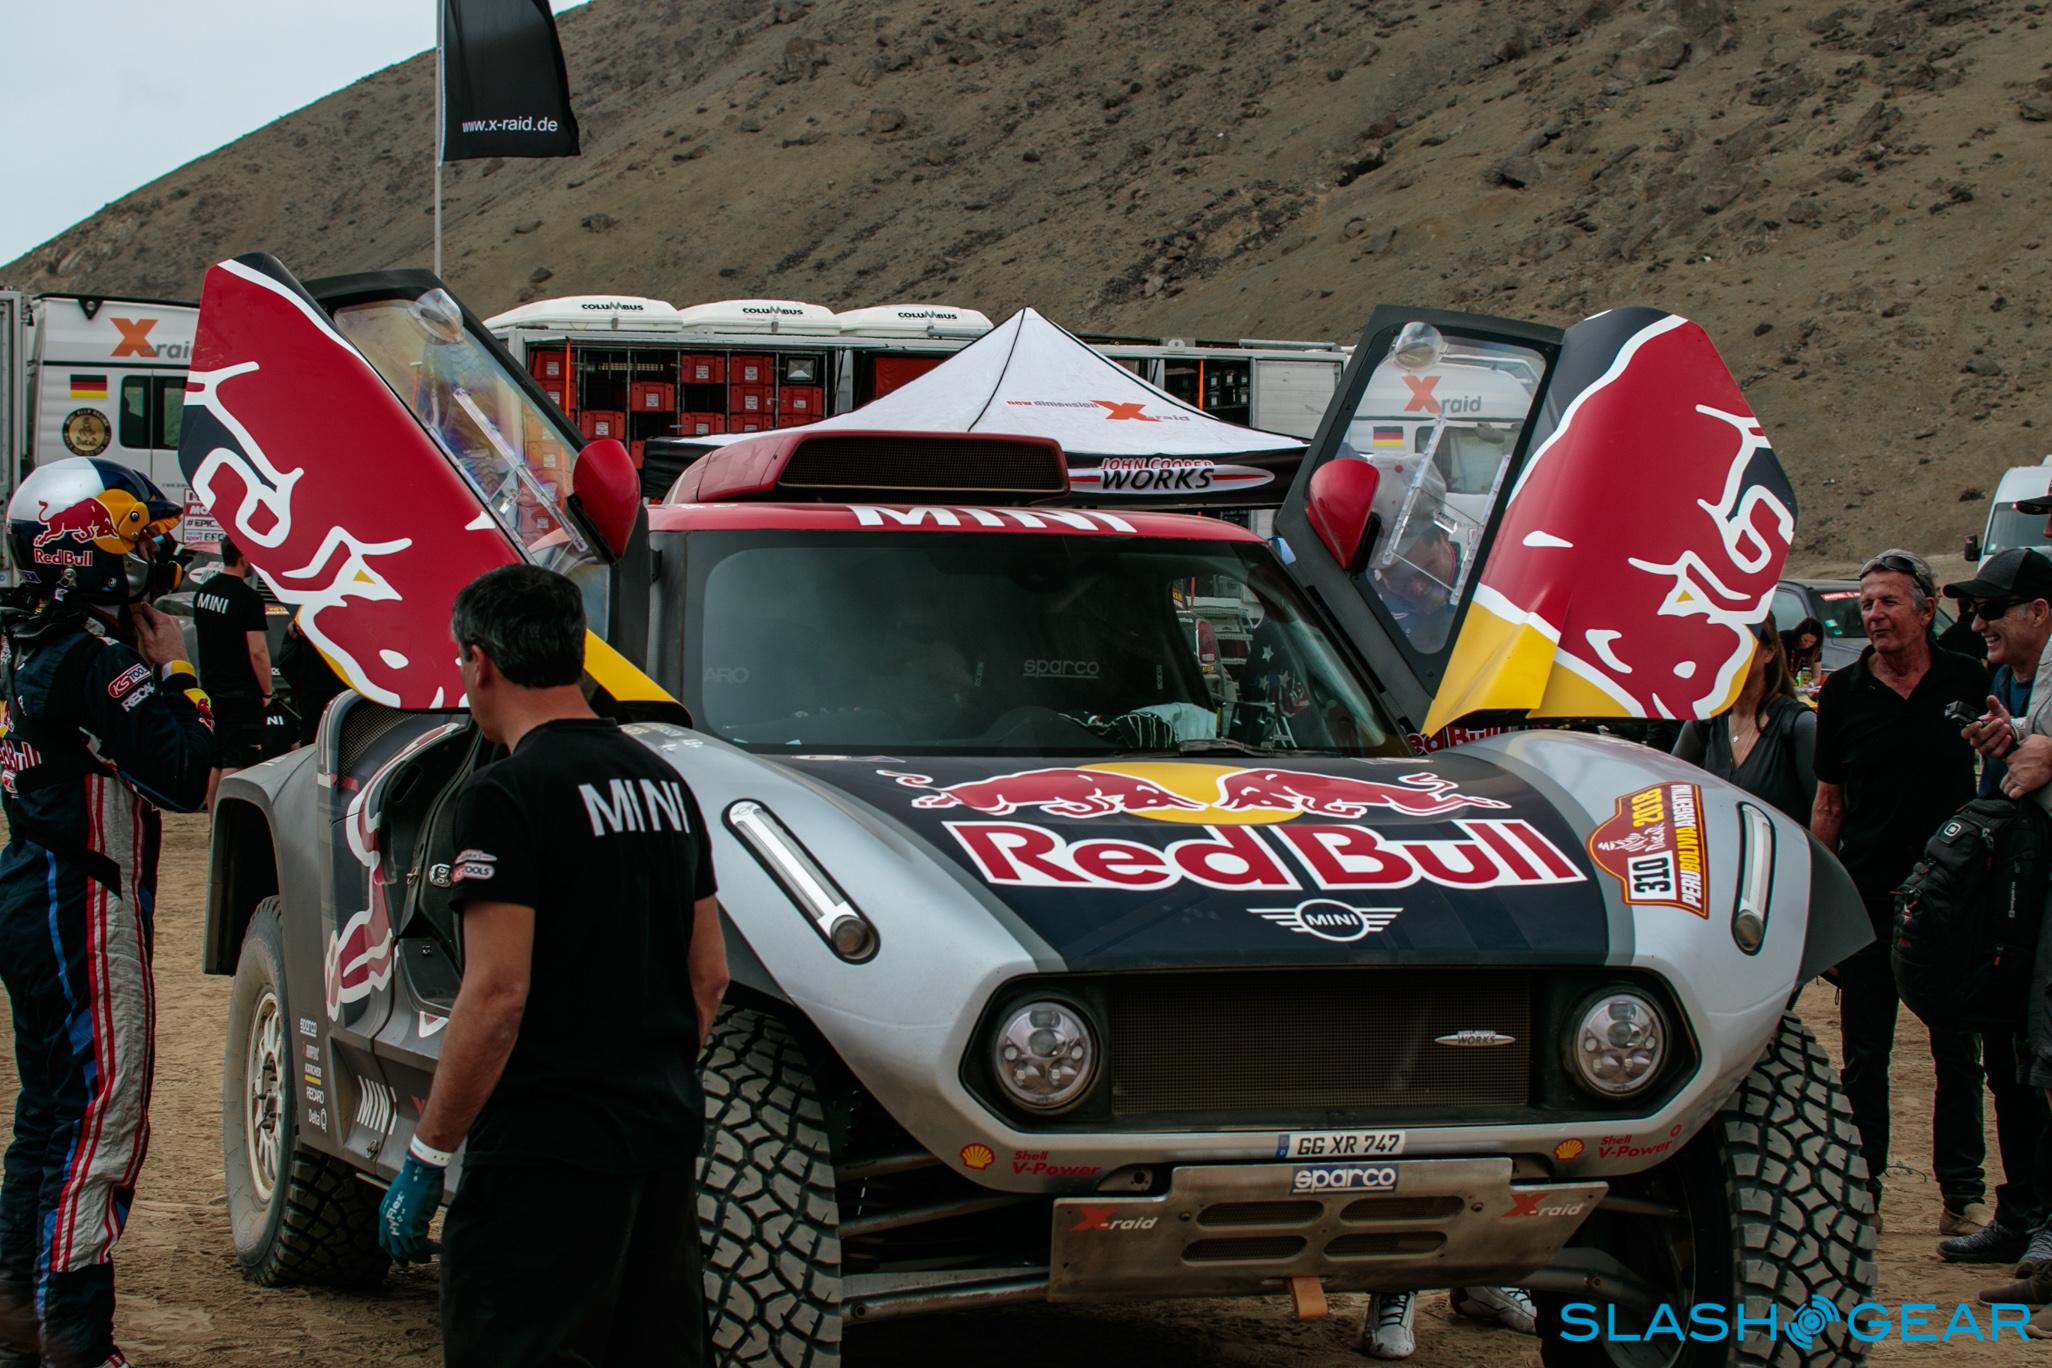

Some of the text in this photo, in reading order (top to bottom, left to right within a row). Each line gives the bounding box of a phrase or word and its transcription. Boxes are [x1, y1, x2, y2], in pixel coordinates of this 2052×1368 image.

[462, 116, 558, 133] www.x-raid.de
[581, 301, 644, 311] COLUMBUS
[742, 306, 803, 316] COLUMBUS
[898, 310, 958, 320] COLUMBUS
[110, 318, 193, 359] X-rai
[1100, 457, 1144, 469] JOHN
[1102, 467, 1215, 490] WORKS
[847, 504, 1137, 533] MINI
[34, 548, 93, 567] Red Bull
[197, 592, 229, 615] MINI
[704, 667, 750, 684] ARO
[1023, 658, 1099, 678] sparco
[266, 715, 285, 726] NI
[577, 778, 691, 837] MINI
[1631, 787, 1664, 828] 2018
[942, 819, 1588, 890] Red Bull
[465, 865, 490, 876] OOLS
[1632, 857, 1671, 893] 310
[1305, 913, 1360, 926] MINI
[1297, 1134, 1400, 1155] GG XR 747
[1599, 1140, 1673, 1159] V-Power
[1601, 1135, 1632, 1146] Shell
[1014, 1151, 1048, 1161] Shell
[1011, 1161, 1100, 1176] V-Power
[1294, 1167, 1397, 1193] sparco
[1502, 1193, 1584, 1218] X-raid
[1072, 1205, 1158, 1232] X-raid
